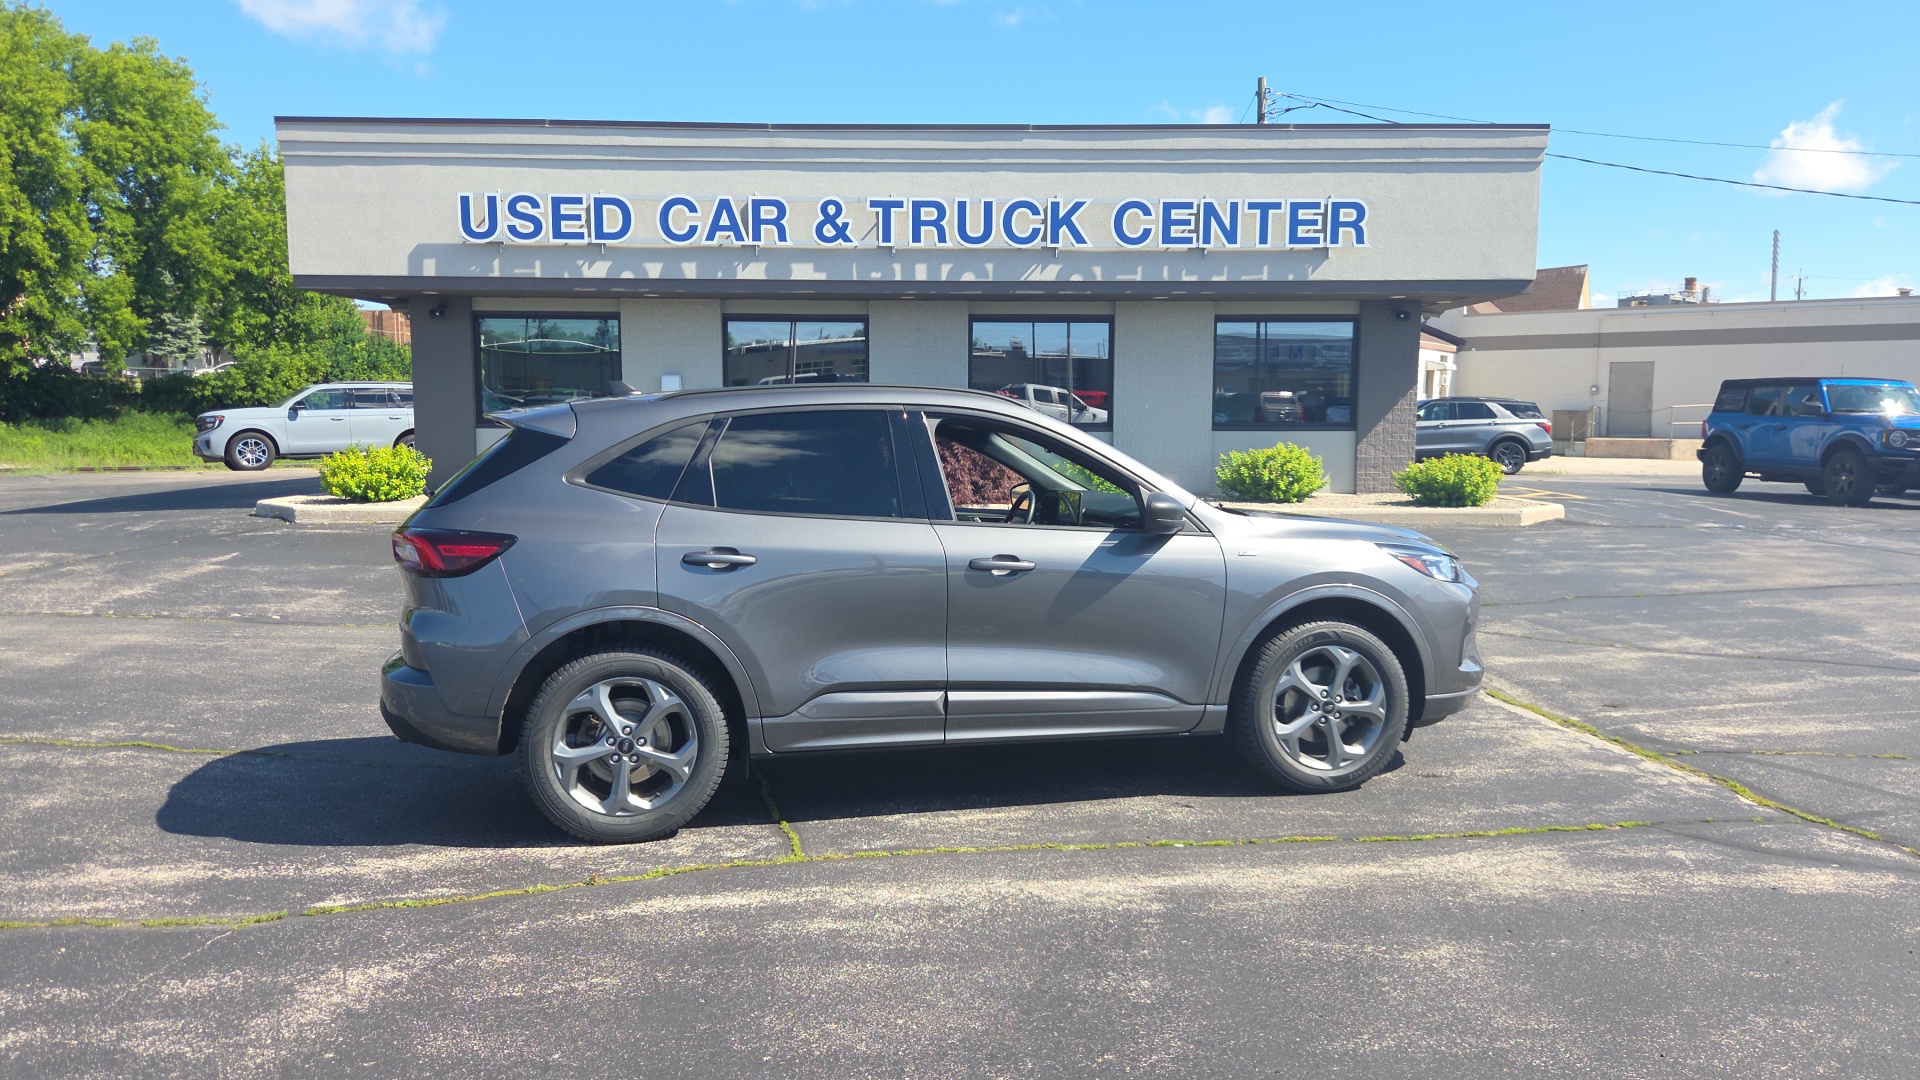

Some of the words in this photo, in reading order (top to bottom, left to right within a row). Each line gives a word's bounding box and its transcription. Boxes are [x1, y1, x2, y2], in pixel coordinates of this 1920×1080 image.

[458, 194, 633, 242] USED
[657, 198, 790, 244] CAR
[814, 197, 856, 245] &
[867, 198, 1090, 246] TRUCK
[1111, 199, 1368, 247] CENTER
